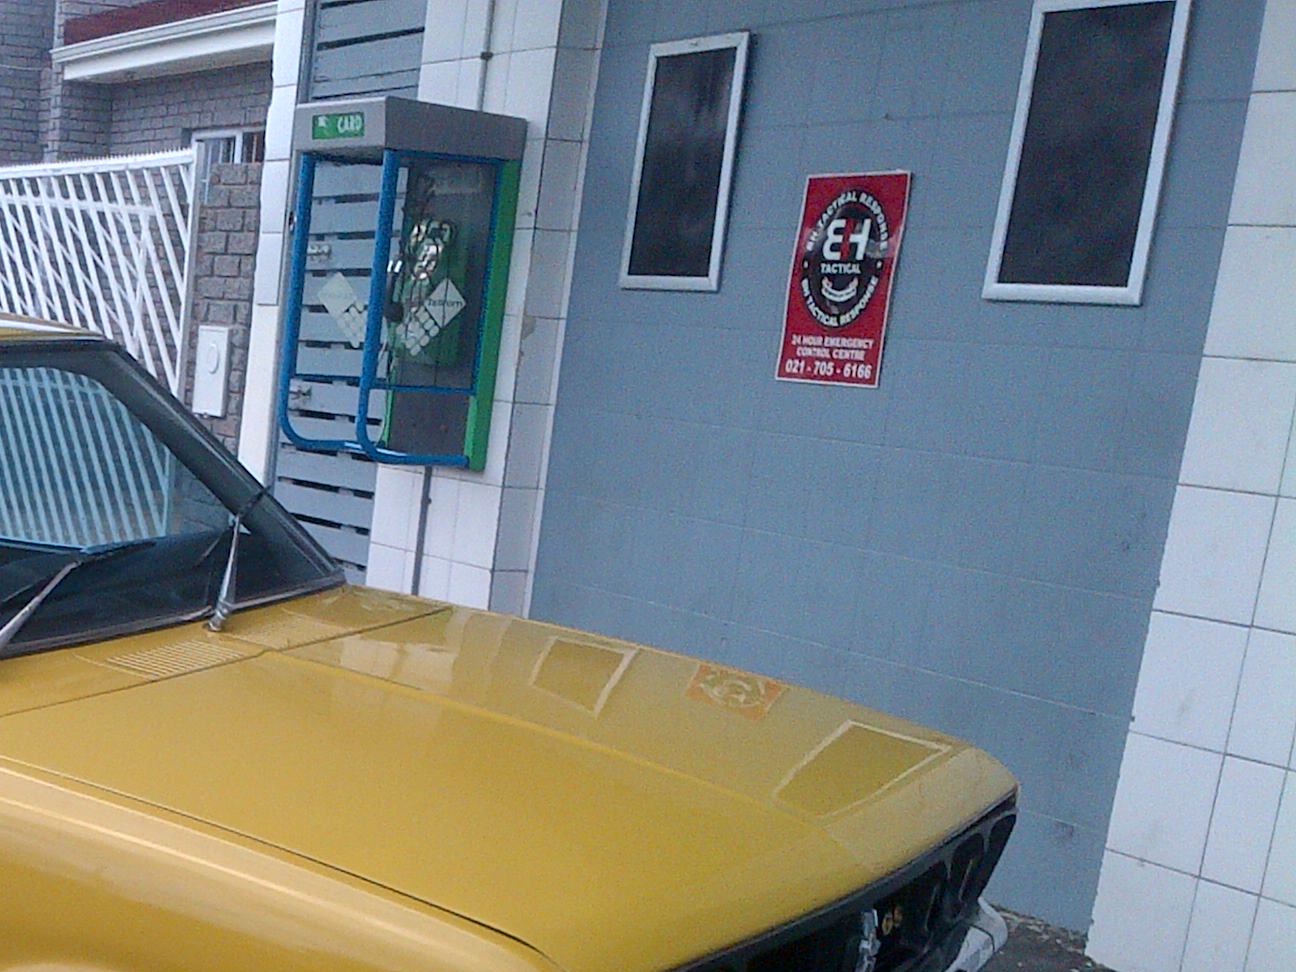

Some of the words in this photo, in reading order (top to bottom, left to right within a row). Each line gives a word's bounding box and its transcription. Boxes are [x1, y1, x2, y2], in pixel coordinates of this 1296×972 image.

[337, 114, 363, 133] CARD
[816, 191, 857, 228] TACTICAL
[859, 192, 888, 250] RESPONSE
[820, 262, 861, 274] TACTICAL
[806, 295, 839, 327] TACTICAL
[839, 275, 879, 326] RESPONSE
[791, 334, 802, 346] 24
[802, 335, 823, 346] HOUR
[824, 336, 874, 349] EMERGENCY
[796, 346, 831, 358] CONTROL
[832, 349, 866, 360] CENTRE
[785, 359, 805, 374] 021
[812, 361, 834, 376] 705
[843, 363, 872, 379] 6166
